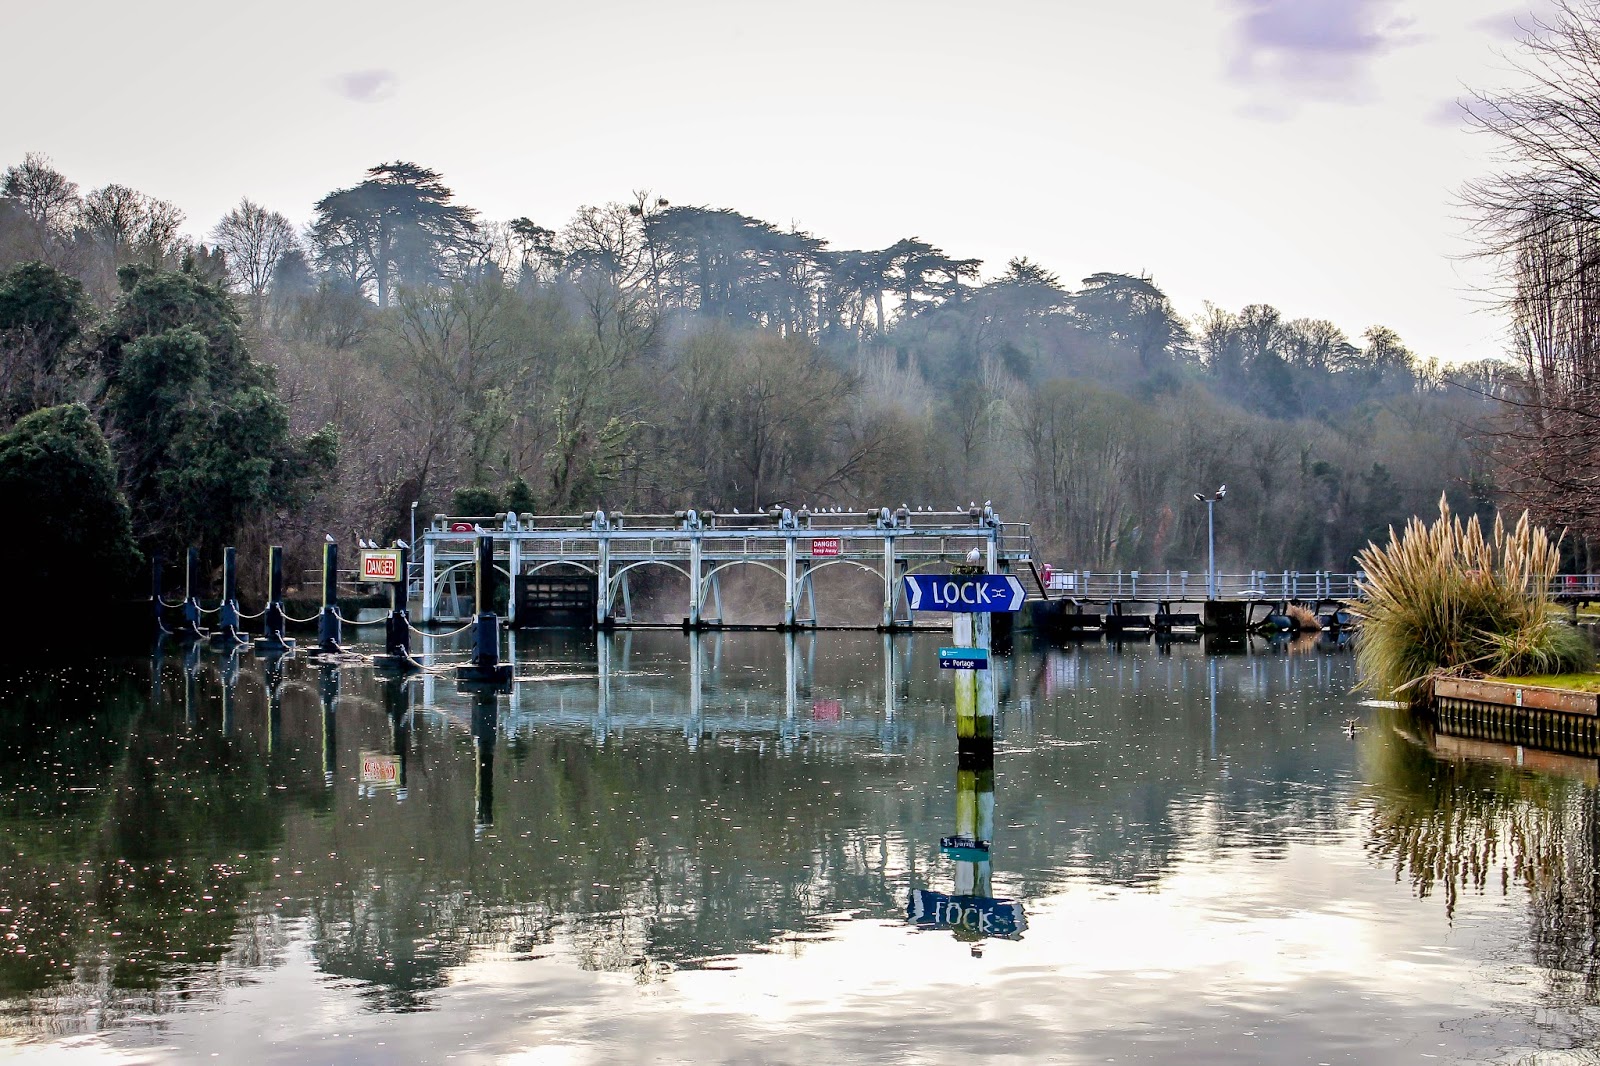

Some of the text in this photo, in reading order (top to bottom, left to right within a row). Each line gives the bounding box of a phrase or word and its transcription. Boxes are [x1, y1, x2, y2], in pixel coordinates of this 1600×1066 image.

[367, 559, 394, 574] DANGER
[932, 581, 992, 604] LOCK
[952, 659, 975, 669] Portage
